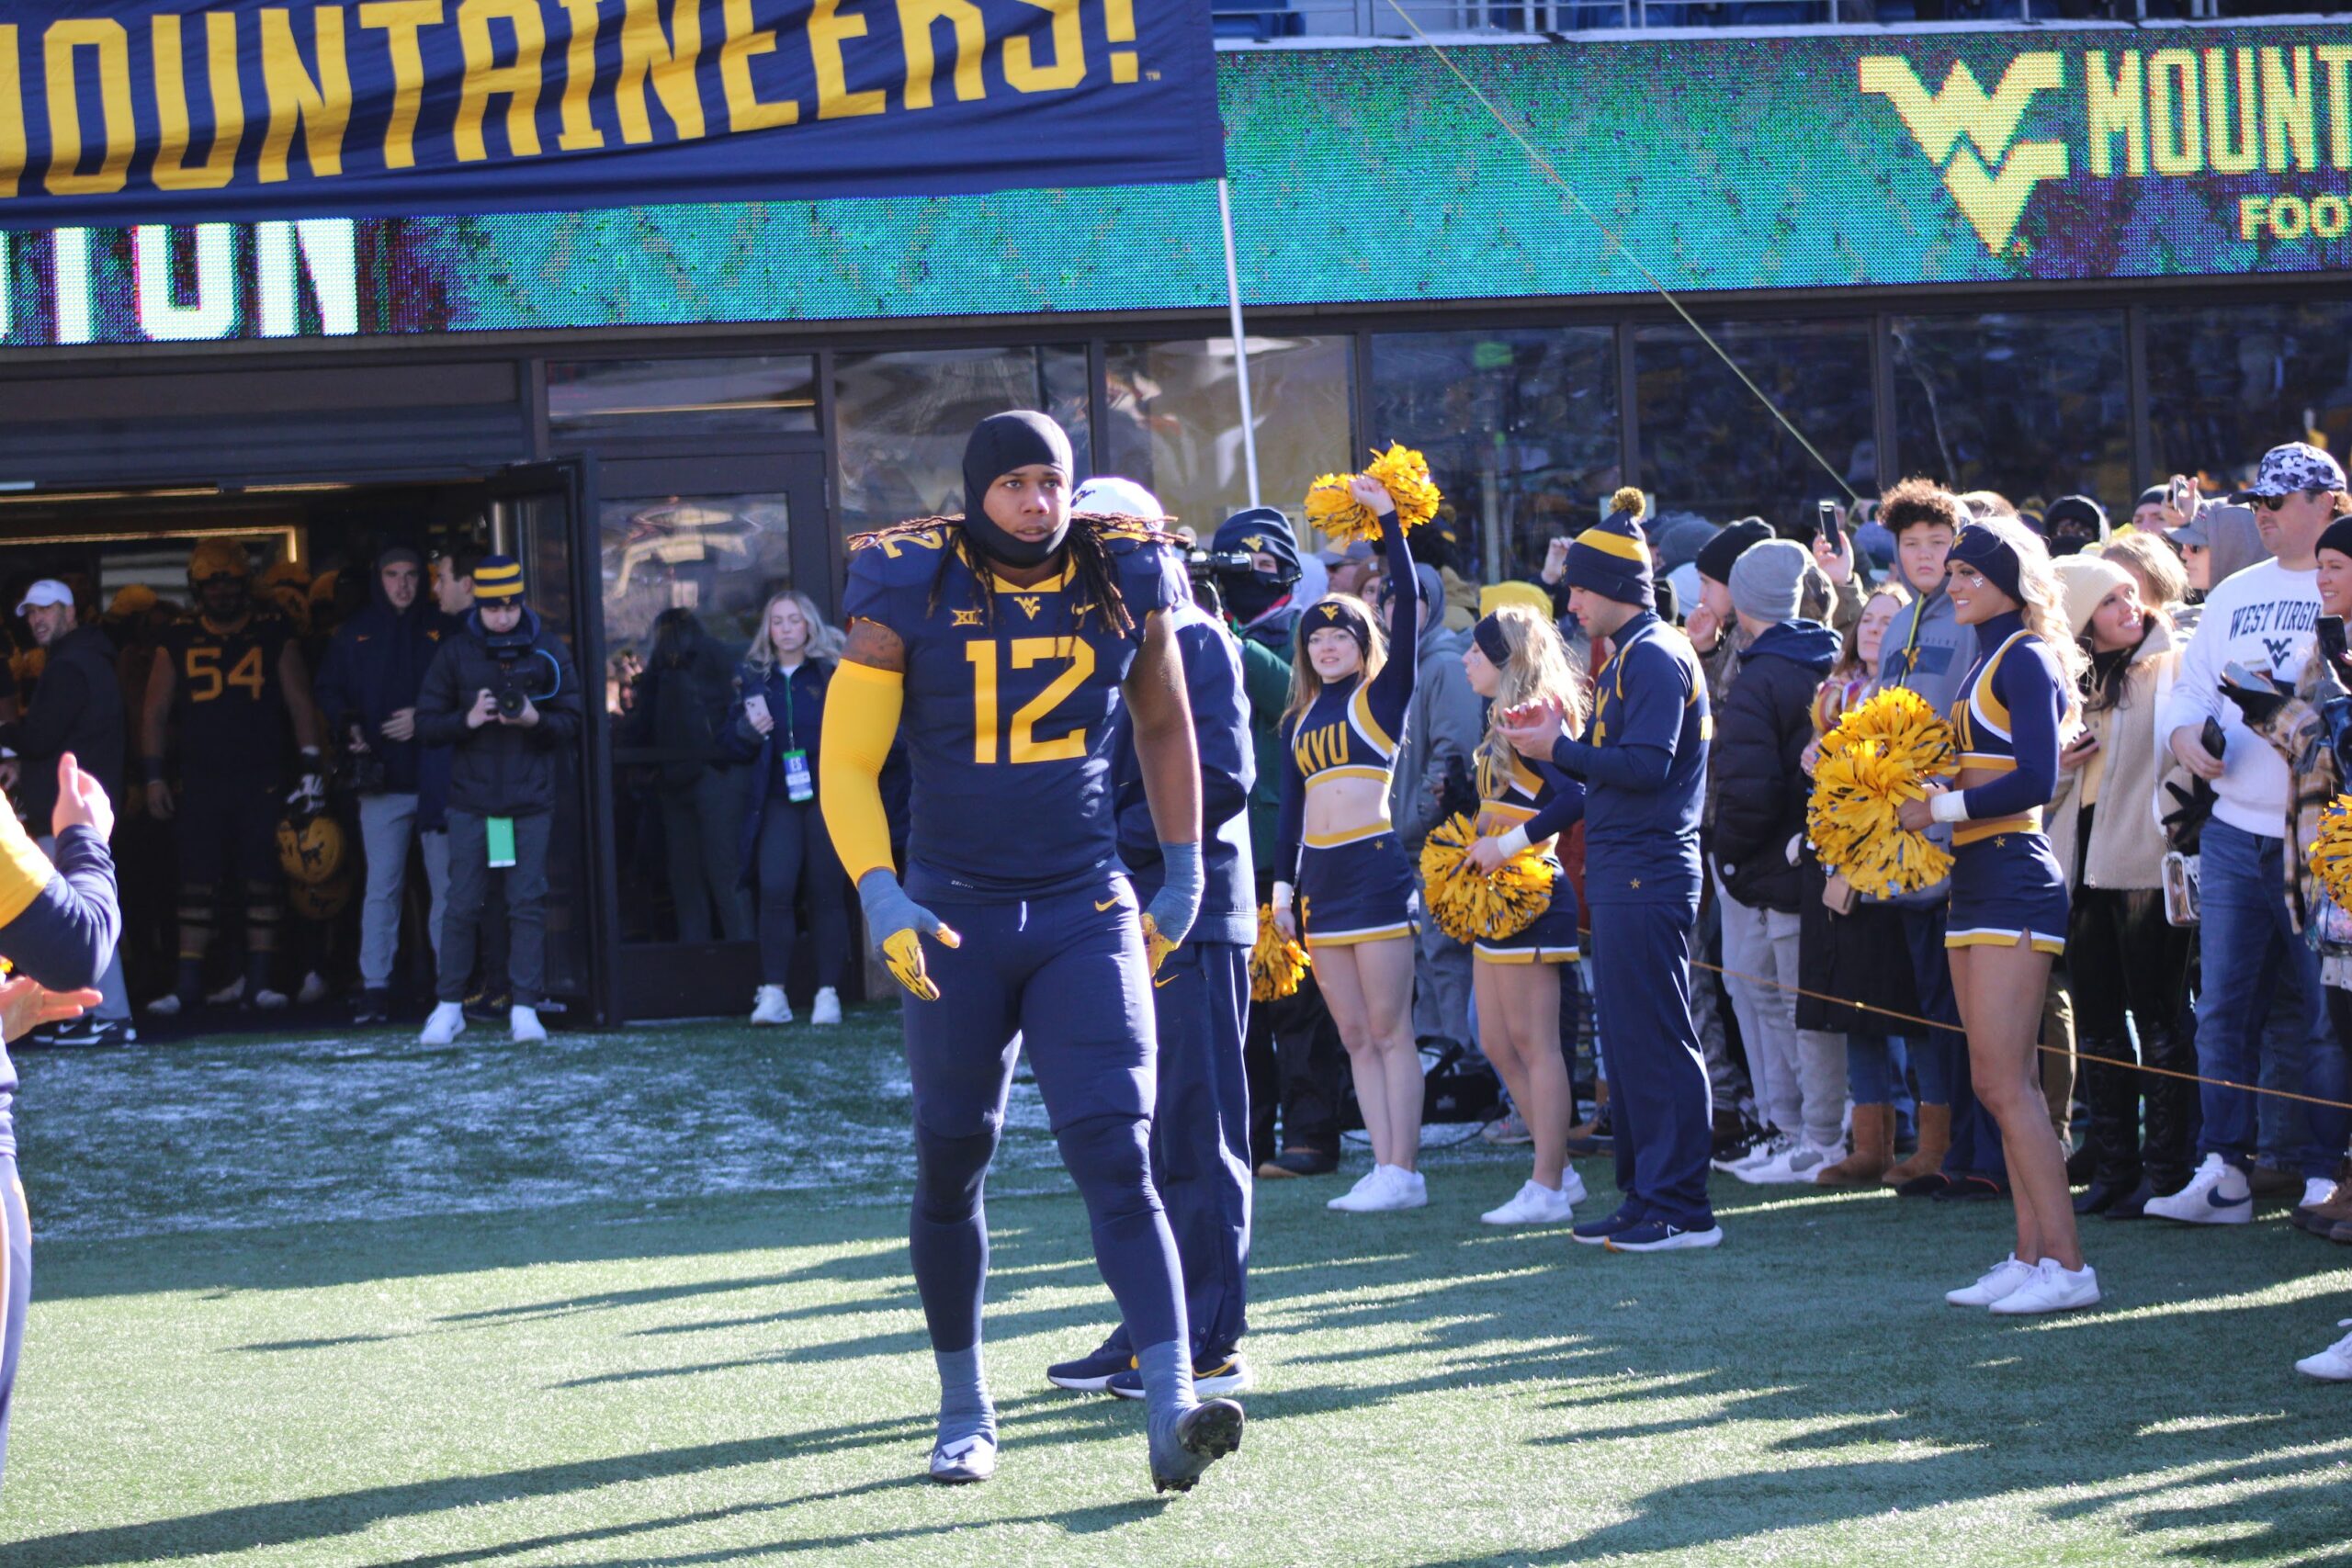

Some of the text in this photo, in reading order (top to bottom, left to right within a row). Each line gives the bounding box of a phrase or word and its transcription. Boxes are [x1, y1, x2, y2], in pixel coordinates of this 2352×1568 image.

[0, 0, 1139, 197] OUNTAINEERS!
[2228, 601, 2276, 641] WEST
[186, 646, 266, 702] 54
[966, 631, 1095, 764] 12
[1295, 720, 1349, 777] WVU
